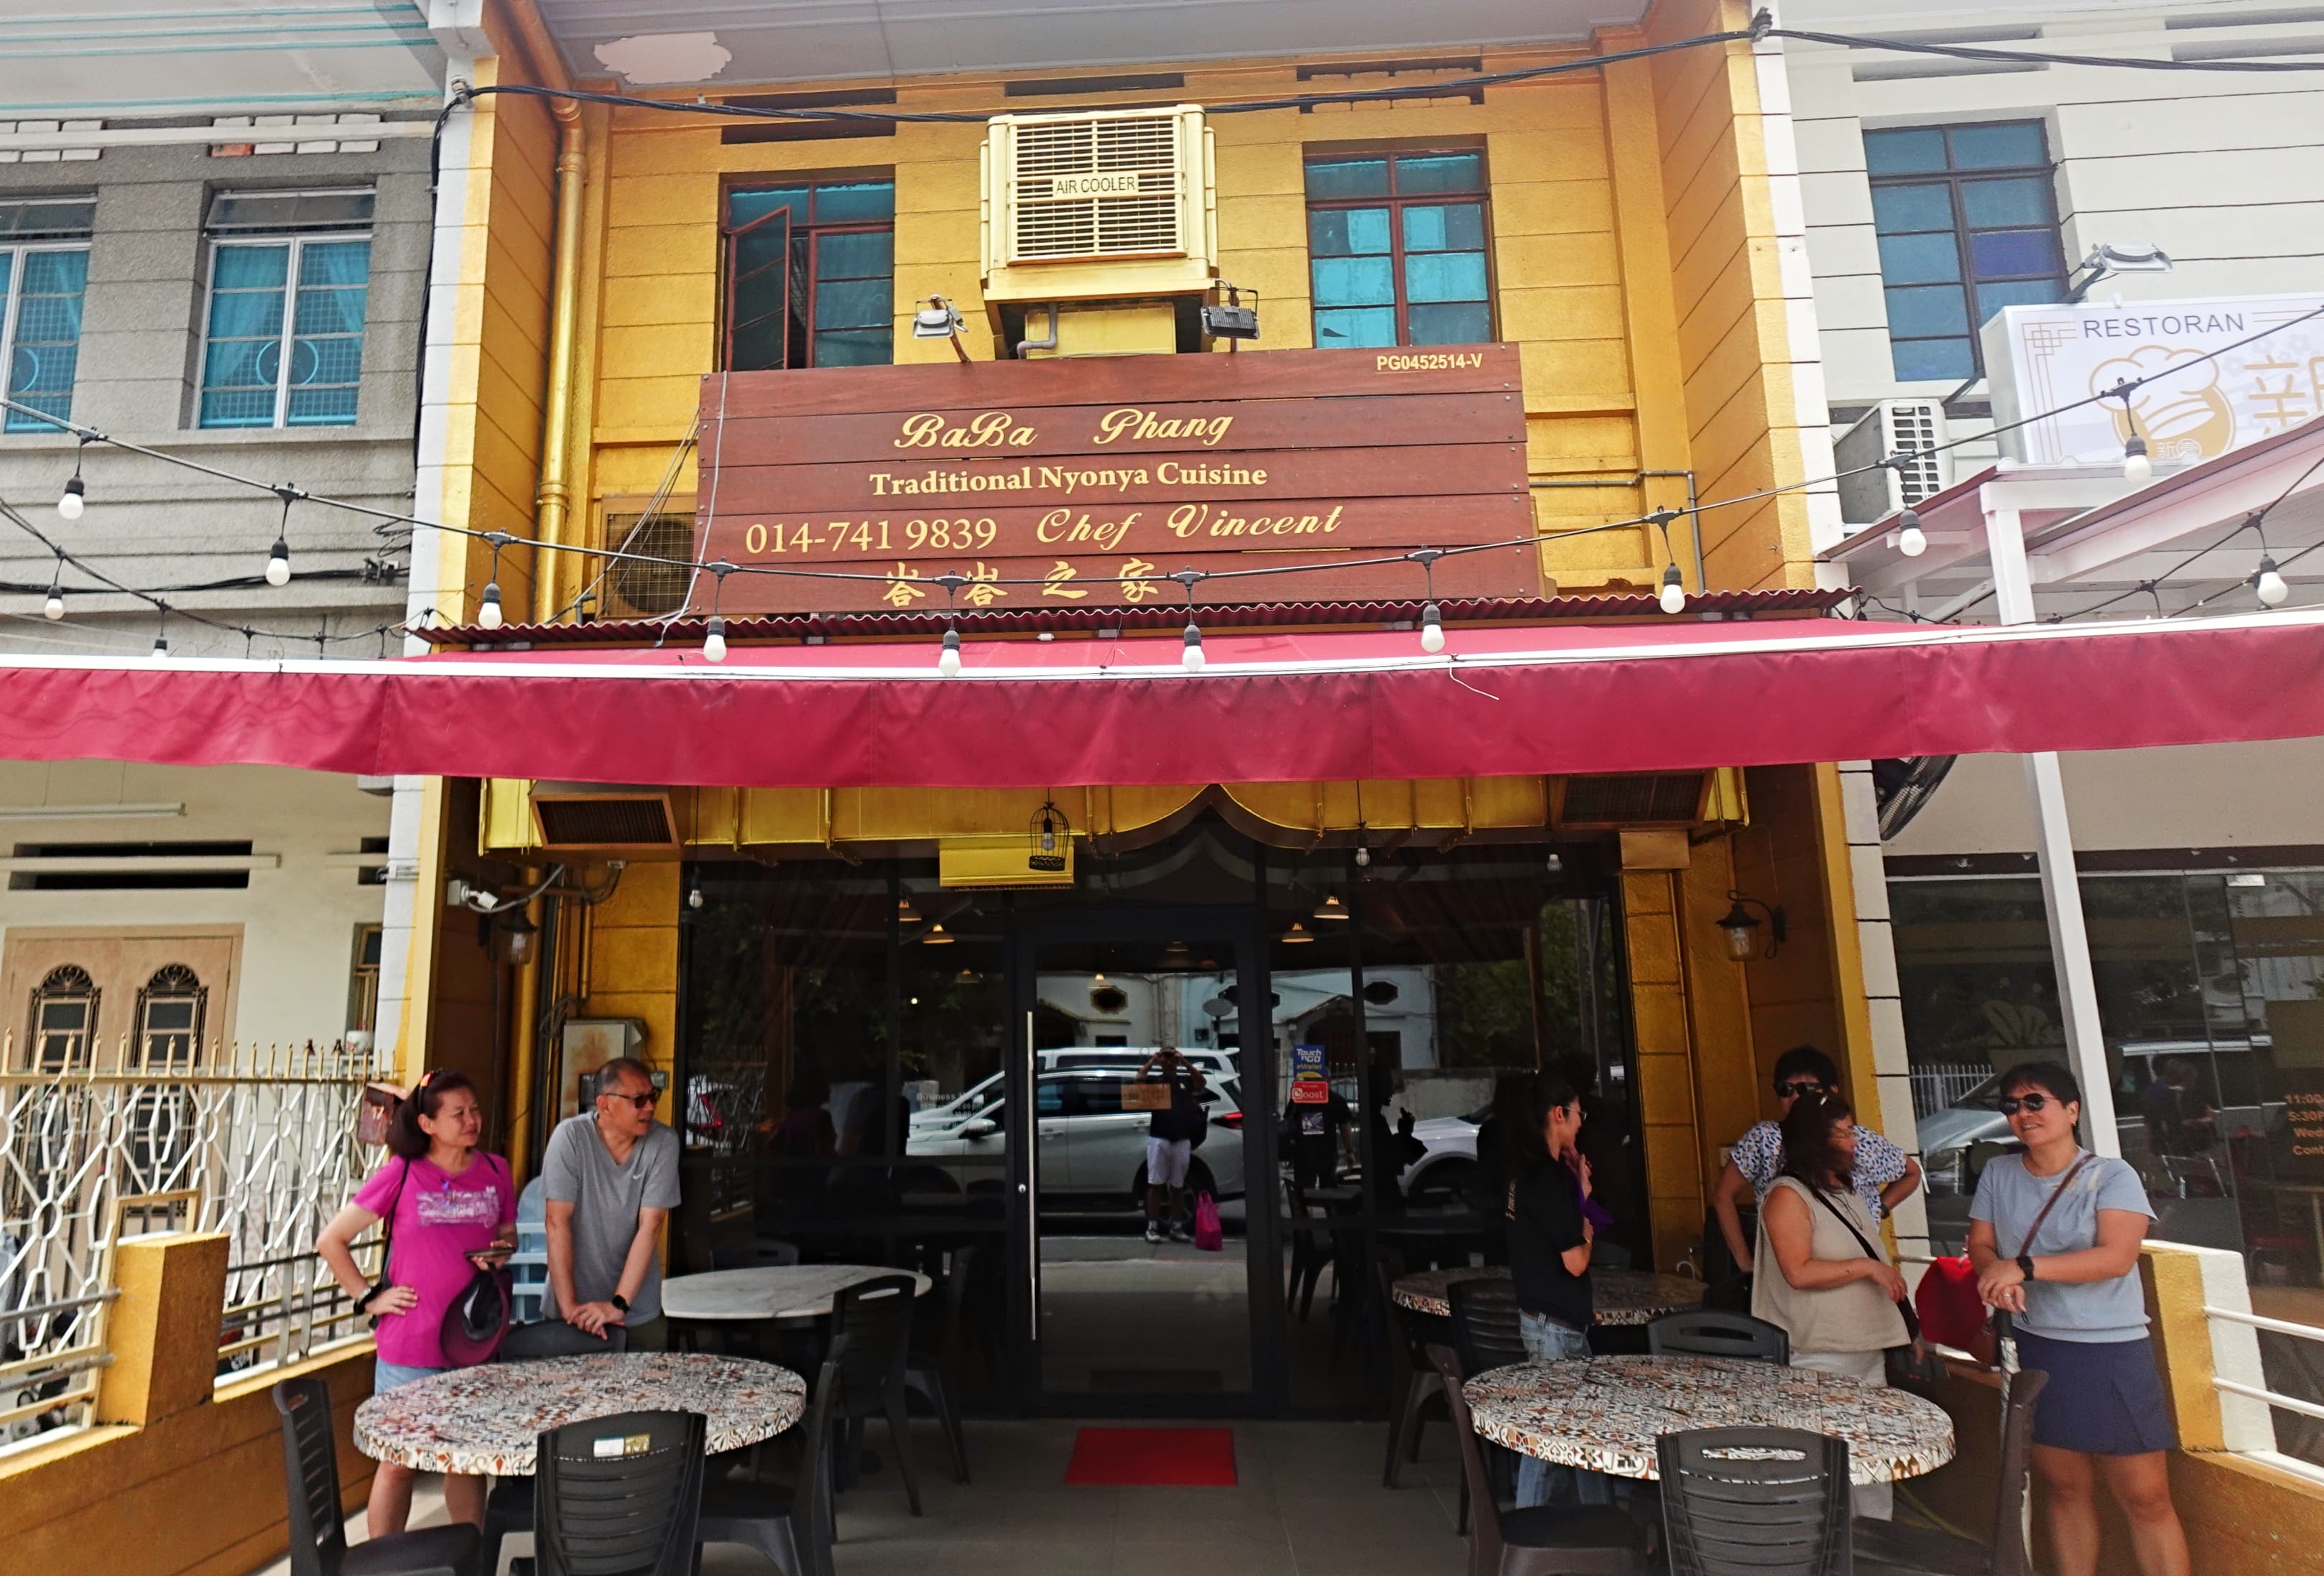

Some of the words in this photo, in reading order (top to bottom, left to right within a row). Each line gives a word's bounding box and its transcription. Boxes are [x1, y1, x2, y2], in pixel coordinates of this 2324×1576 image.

[1057, 180, 1078, 194] AIR
[1081, 177, 1135, 193] COOLER
[2083, 312, 2244, 338] RESTORAN
[1376, 353, 1483, 371] PG0452514-V
[894, 411, 1038, 448] BaBa
[1093, 408, 1233, 446] Phang
[869, 466, 1033, 496] Traditional
[1038, 465, 1150, 494] Nyonya
[1157, 462, 1268, 486] Cuisine
[746, 520, 892, 554] 014-741
[905, 518, 996, 550] 9839
[1037, 508, 1143, 551] Chef
[1167, 504, 1343, 538] Vincent
[882, 557, 1159, 608] 峇峇之家
